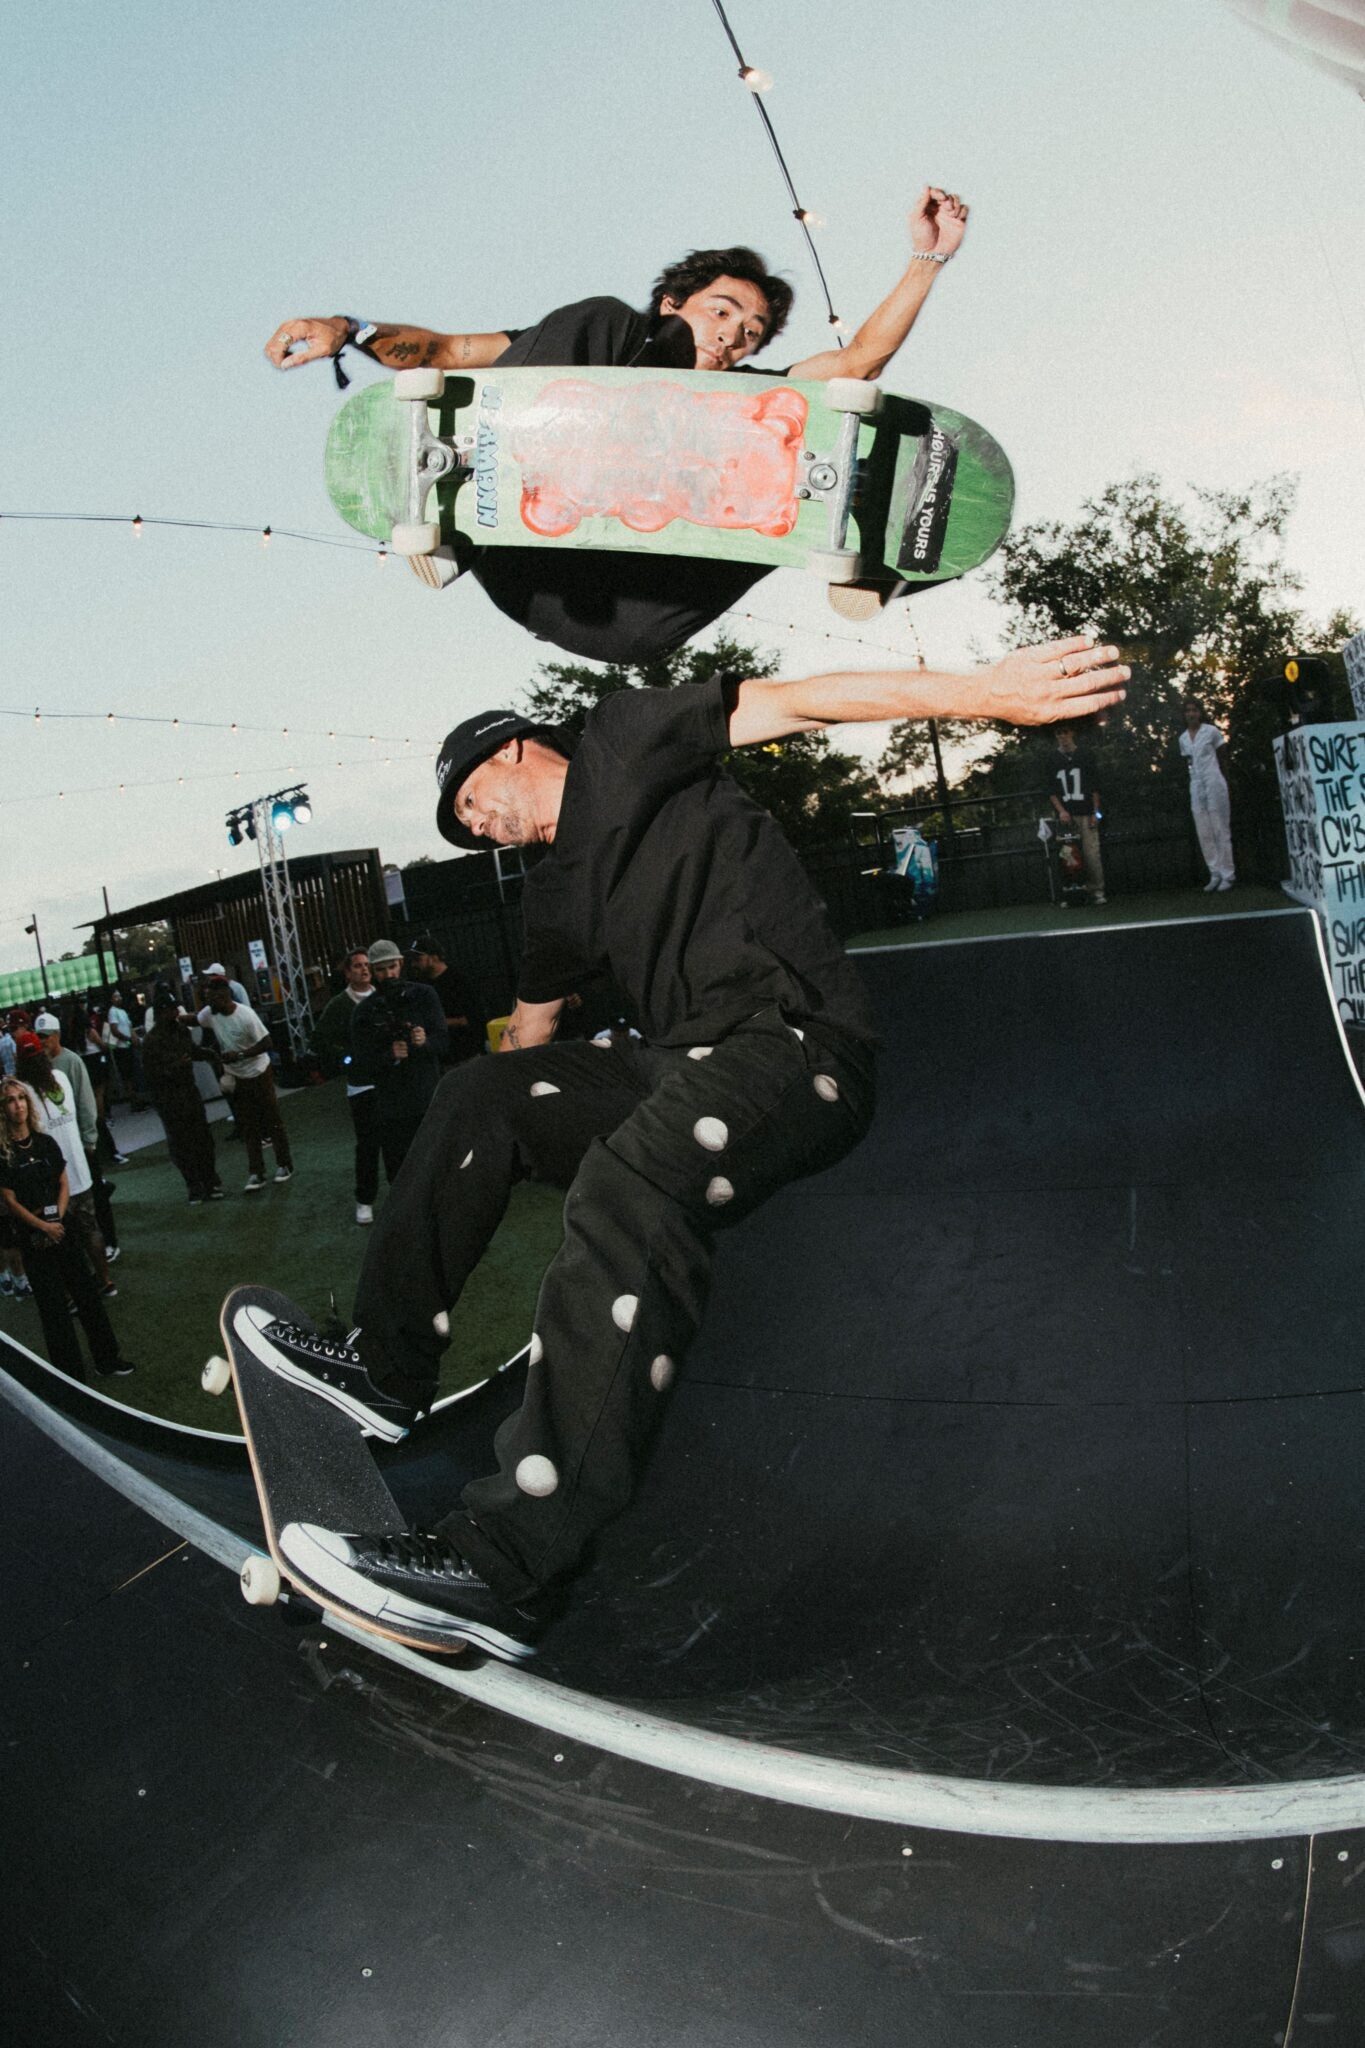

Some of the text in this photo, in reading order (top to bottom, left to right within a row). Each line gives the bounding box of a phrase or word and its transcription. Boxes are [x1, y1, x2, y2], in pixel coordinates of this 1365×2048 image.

[477, 386, 502, 528] HRMANN
[913, 506, 935, 560] YOURS
[1309, 733, 1360, 773] SURE
[1056, 767, 1084, 802] 11
[1315, 774, 1358, 816] THE
[1321, 813, 1365, 858] CLUB
